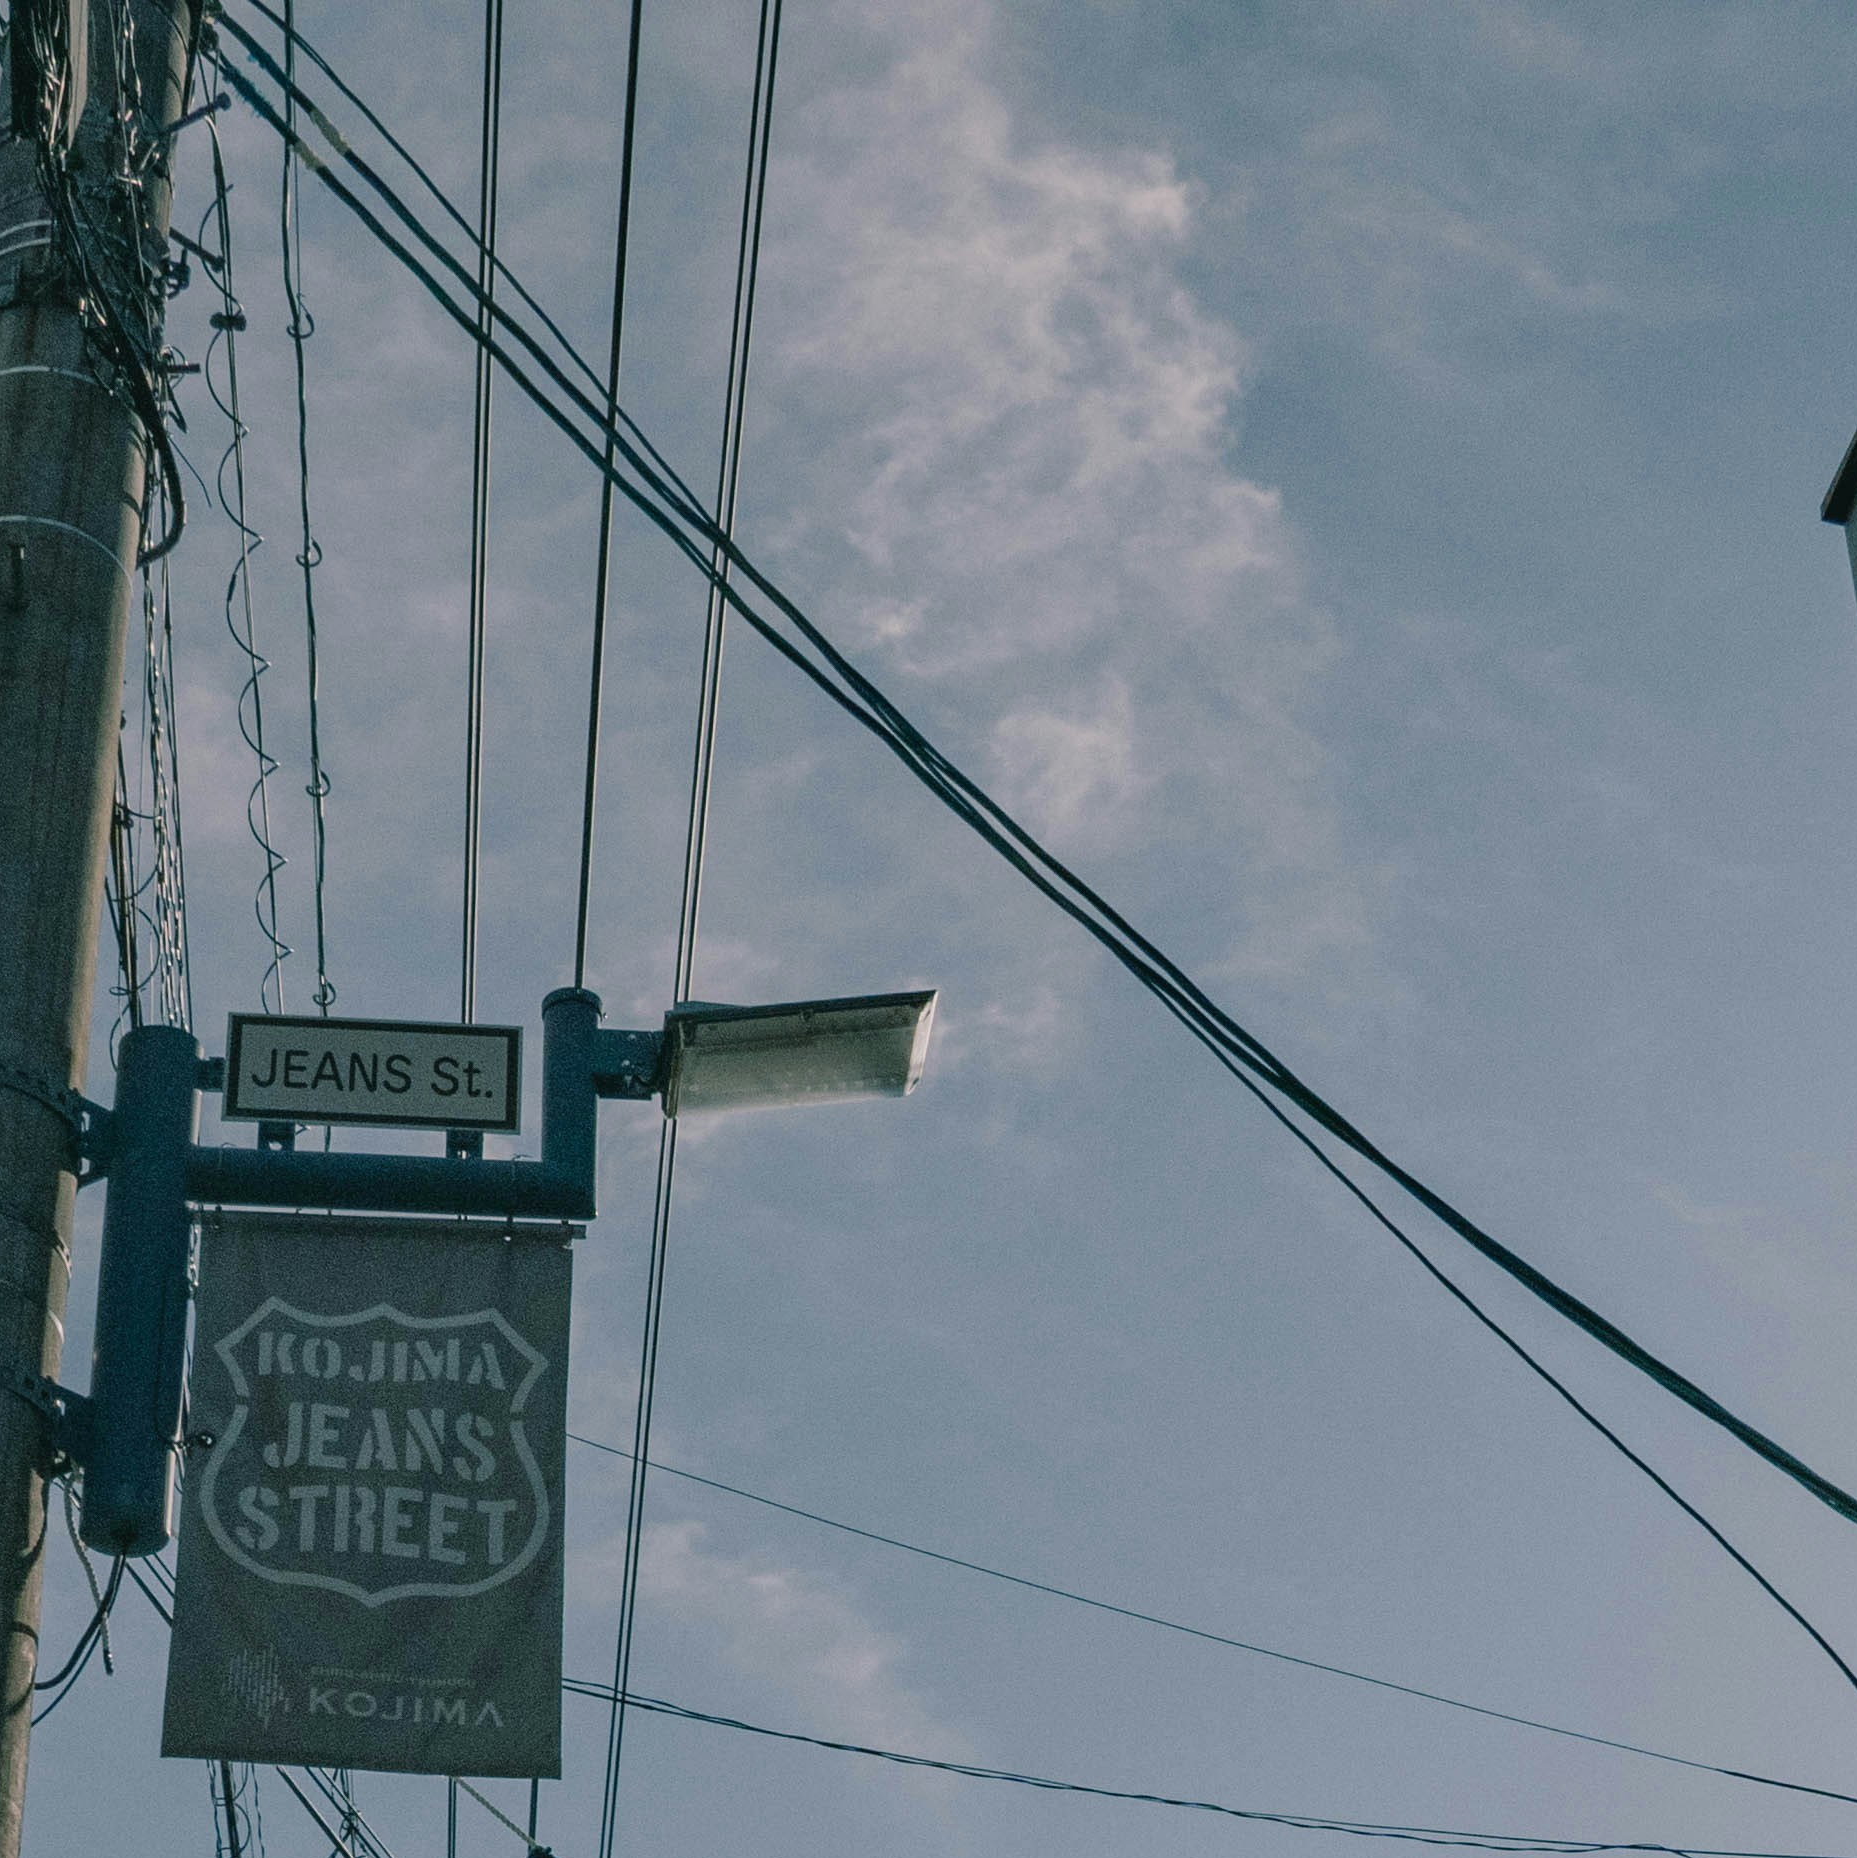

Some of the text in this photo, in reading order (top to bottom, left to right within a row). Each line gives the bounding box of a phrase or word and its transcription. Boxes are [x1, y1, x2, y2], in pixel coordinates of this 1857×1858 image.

[251, 1049, 494, 1099] JEANS St.
[257, 1331, 506, 1391] KOJIMA
[262, 1402, 496, 1483] JEANS
[236, 1486, 517, 1566] STREET
